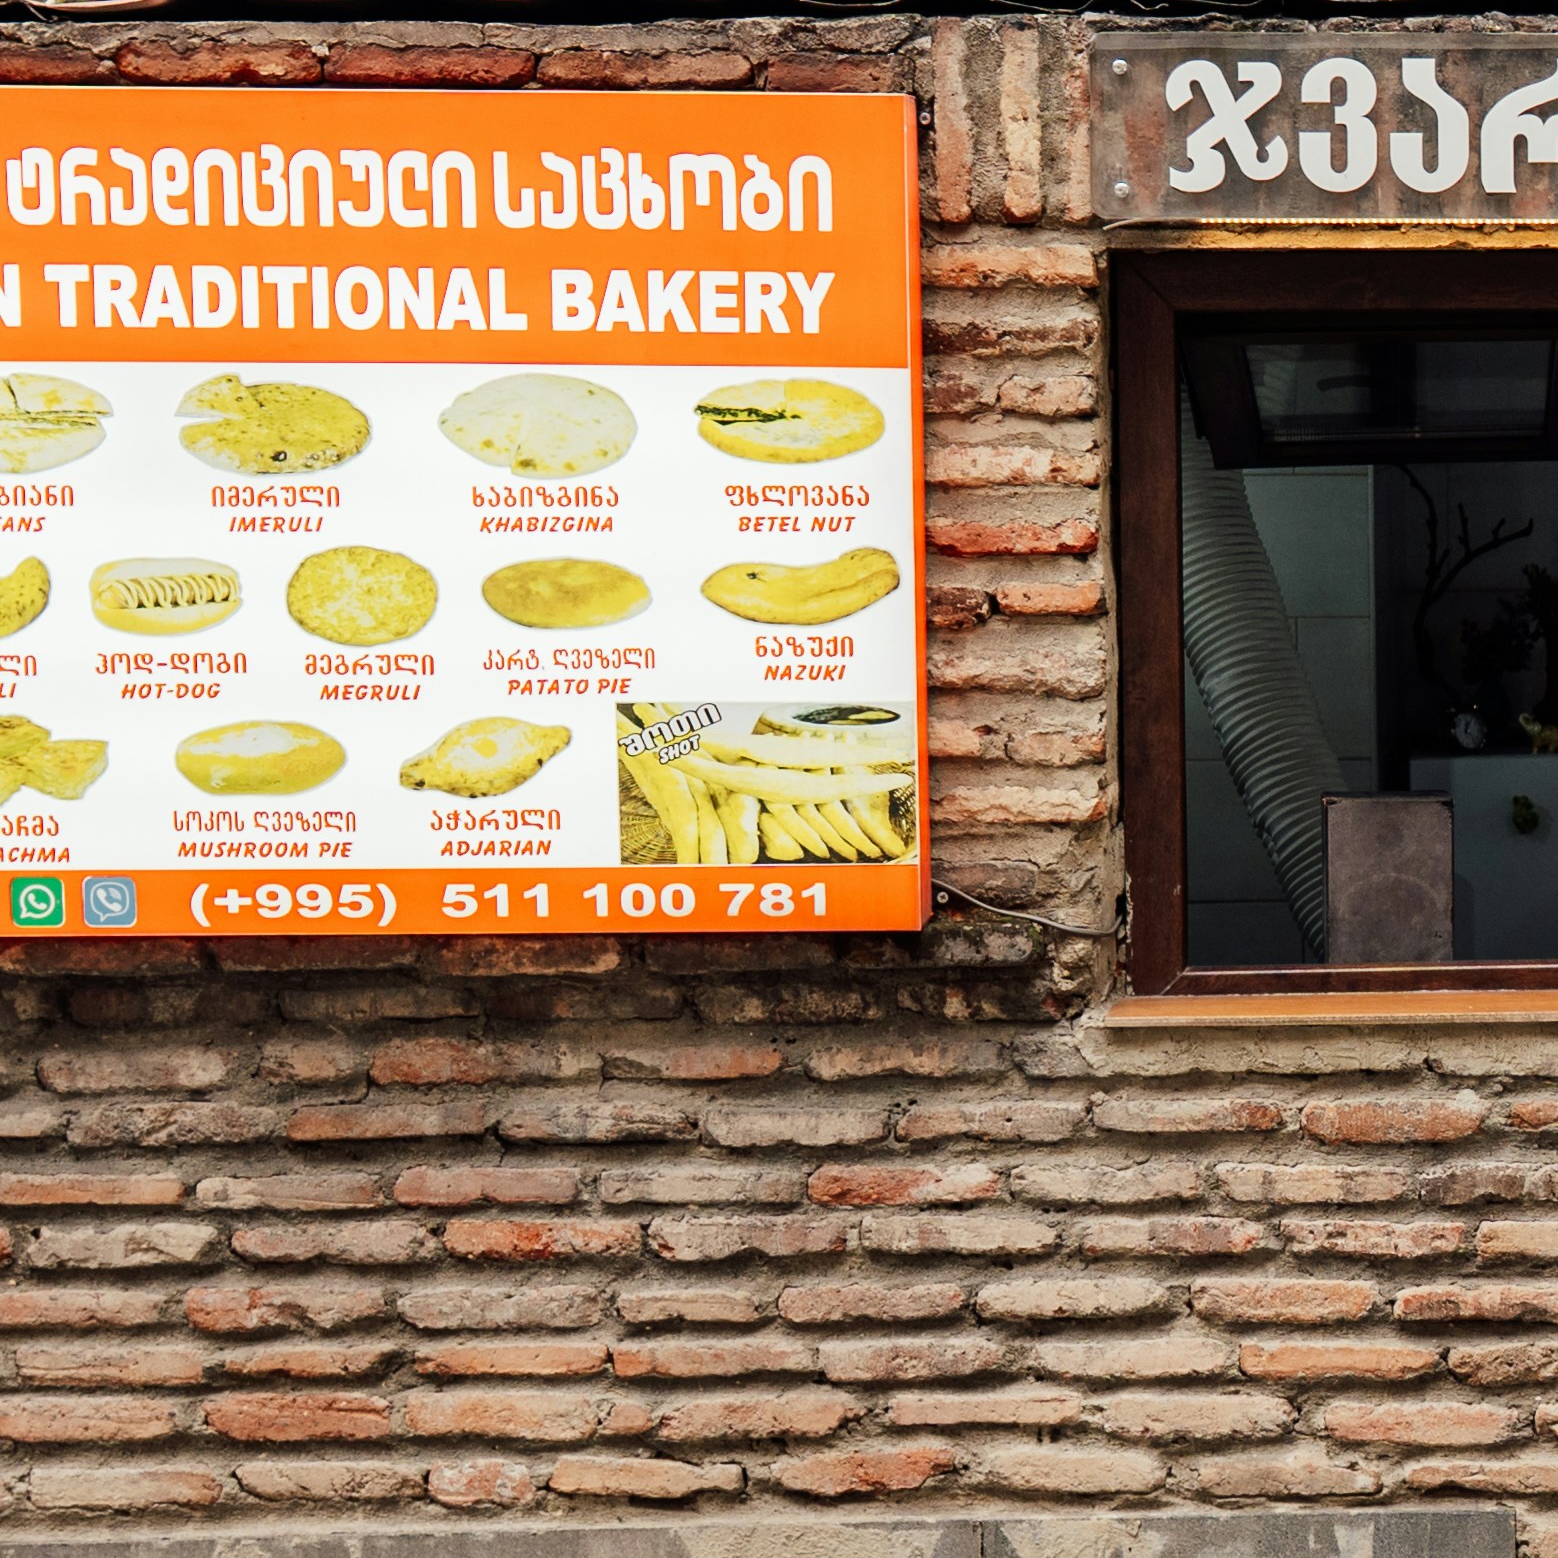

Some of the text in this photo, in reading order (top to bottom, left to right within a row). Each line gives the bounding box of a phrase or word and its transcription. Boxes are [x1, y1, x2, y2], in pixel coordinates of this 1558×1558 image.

[6, 145, 832, 232] ტრადიციული საცხობი
[43, 264, 528, 330] TRADITIONAL
[551, 269, 835, 334] BAKERY
[211, 485, 340, 507] იმერული
[472, 485, 619, 508] ხაბიზგინა
[724, 485, 870, 507] ფხლოვანა
[229, 516, 323, 533] IMERULI
[480, 516, 613, 534] KHABIZGINA
[738, 516, 856, 532] BETEL NUT
[755, 635, 854, 658] ნაზუქი
[95, 652, 247, 675] ჰოდ-დოგი
[304, 653, 435, 677] მეგრული
[552, 647, 656, 670] ღვეზელი
[764, 664, 847, 682] NAZUKI
[121, 682, 221, 699] HOT-DOG
[320, 684, 421, 701] MEGRULI
[508, 678, 632, 695] PATATO PIE
[618, 702, 722, 757] შოთი
[658, 734, 701, 765] SHOT
[173, 810, 357, 833] სოკოს ღვეზელი
[430, 809, 561, 831] აჭარული
[177, 842, 353, 859] MUSHROOM PIE
[440, 840, 552, 857] ADJARIAN
[190, 881, 829, 928] (+995) 511 100 781
